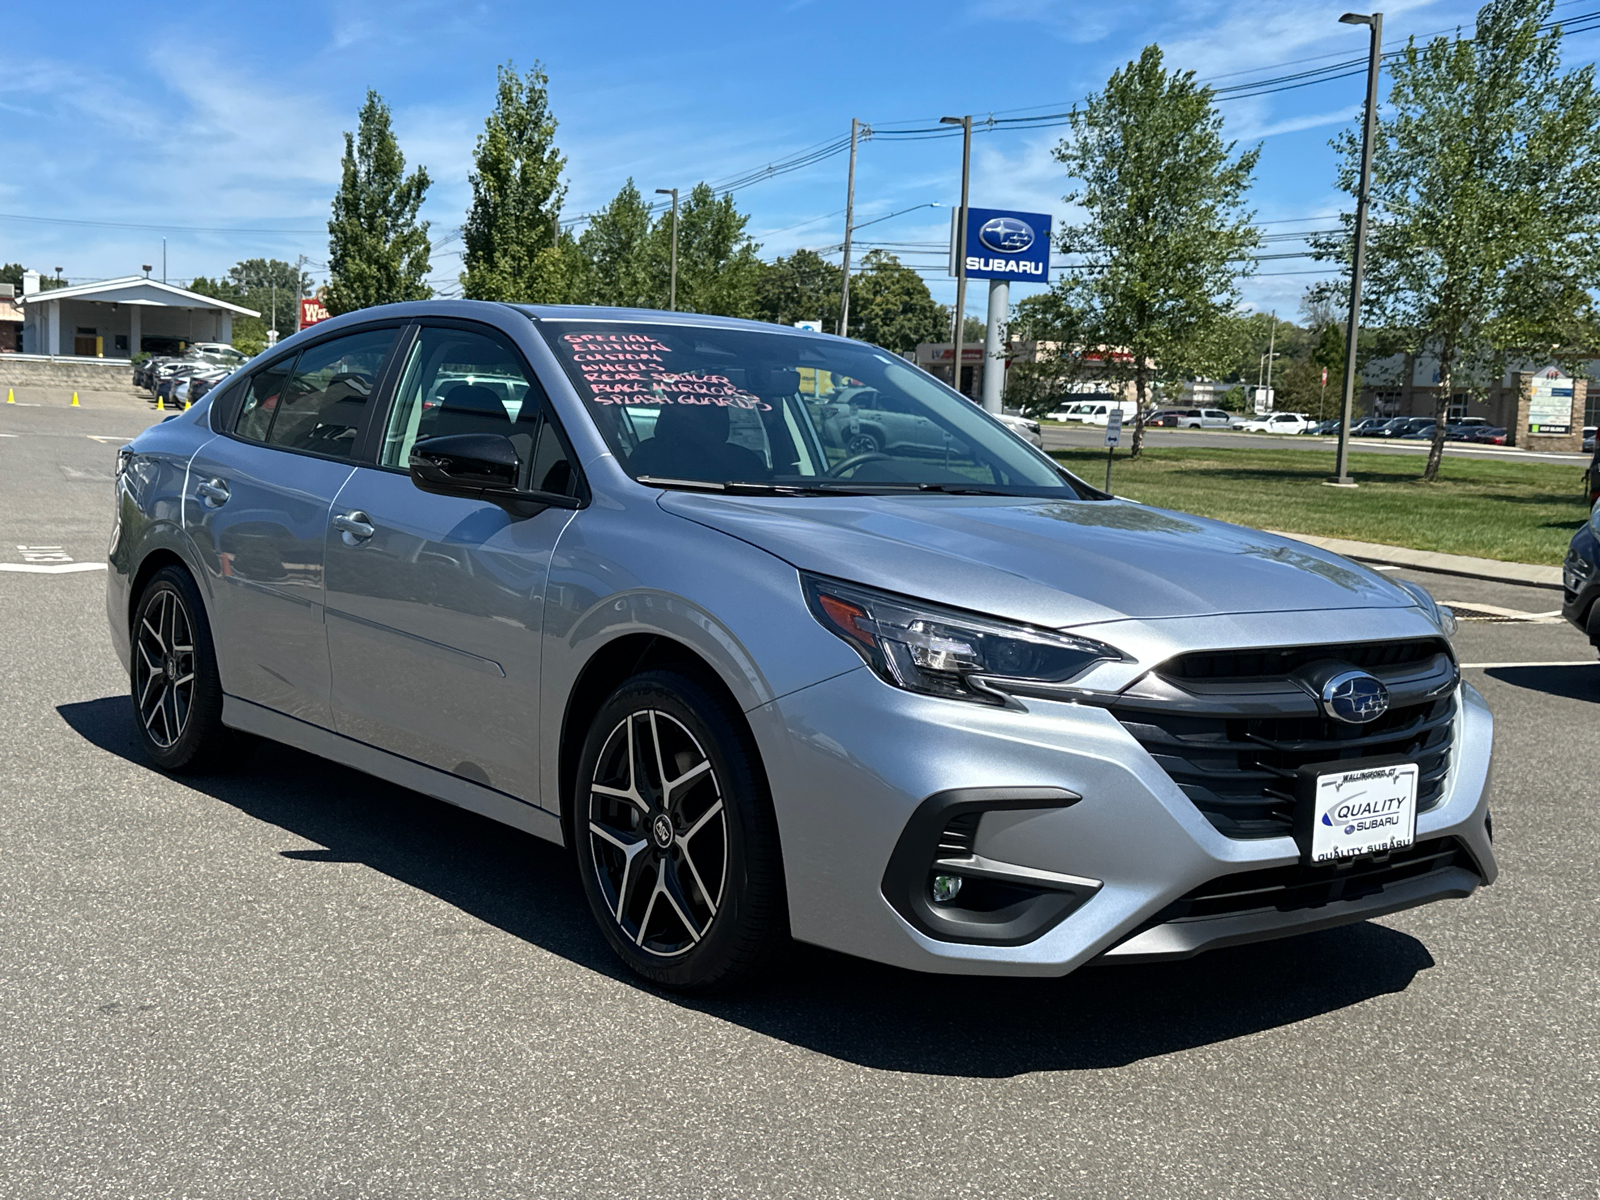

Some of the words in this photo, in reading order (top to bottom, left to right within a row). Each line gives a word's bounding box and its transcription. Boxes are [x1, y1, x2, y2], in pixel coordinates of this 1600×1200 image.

[966, 257, 1043, 275] SUBARU
[564, 335, 657, 343] SPECIAL
[572, 343, 672, 352] EDITION
[573, 353, 663, 361] CUSTOM
[581, 363, 665, 371] WHEELS
[584, 373, 648, 381] REAR
[650, 373, 731, 387] SPOILER
[590, 383, 648, 393] BLACK
[653, 382, 760, 403] MIRRORS
[594, 394, 674, 405] SPLASH
[677, 394, 772, 411] GUARDS
[1337, 796, 1406, 819] QUALITY
[1356, 816, 1399, 831] SUBARU
[1318, 845, 1363, 861] QUALITY
[1367, 838, 1411, 853] SUBARU
